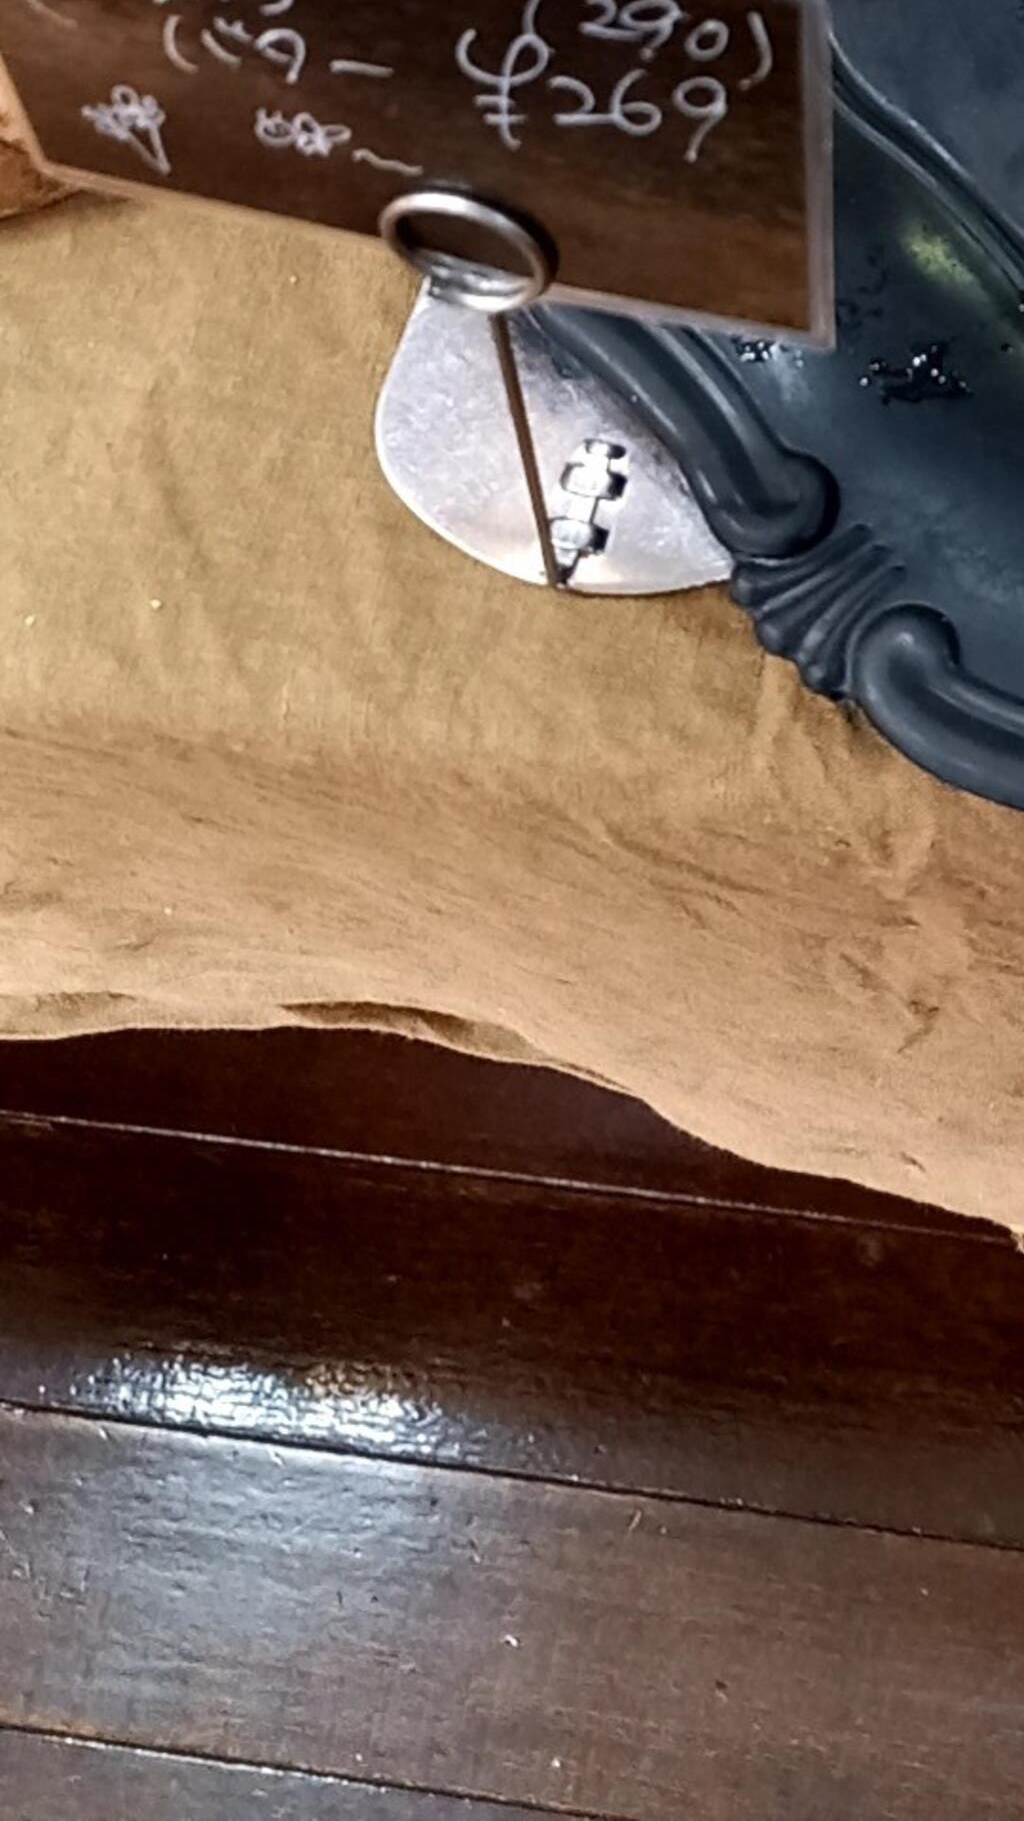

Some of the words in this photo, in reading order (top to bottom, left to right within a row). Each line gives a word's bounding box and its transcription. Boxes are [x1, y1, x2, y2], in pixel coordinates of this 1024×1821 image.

[161, 14, 395, 86] バター
[454, 27, 729, 164] ¥269
